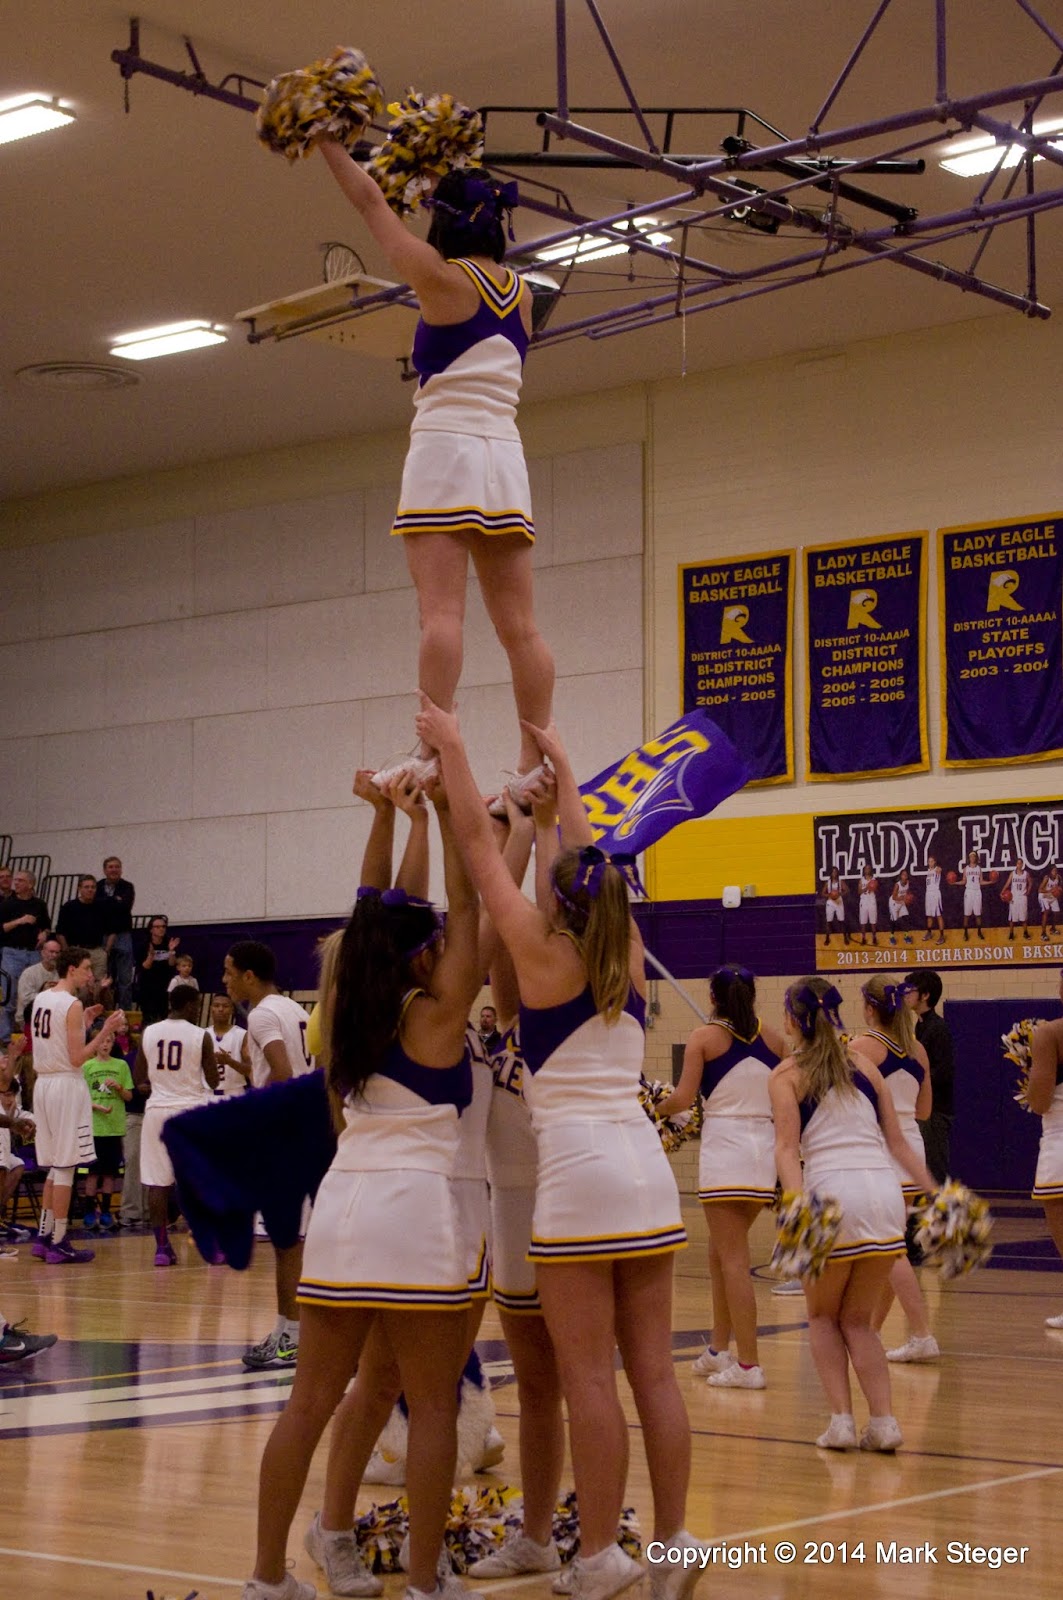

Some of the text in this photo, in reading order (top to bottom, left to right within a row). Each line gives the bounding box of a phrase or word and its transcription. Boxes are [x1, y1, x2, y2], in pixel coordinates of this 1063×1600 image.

[953, 525, 1055, 553] LADY EAGLE
[817, 546, 911, 571] LADY EAGLE
[951, 543, 1057, 570] BASKETBALL
[692, 563, 781, 587] LADY EAGLE
[815, 563, 912, 588] BASKETBALL
[689, 580, 782, 604] BASKETBALL
[986, 569, 1025, 613] R
[847, 588, 883, 630] R
[720, 604, 755, 645] R
[953, 611, 1057, 632] DISTRICT 10-AAAAA
[814, 628, 910, 648] DISTRICT 10-AAAAA
[982, 628, 1029, 644] STATE
[691, 643, 781, 662] DISTRICT 10-AAAAA
[832, 644, 898, 662] DISTRICT
[968, 642, 1045, 662] PLAYOFFS
[697, 657, 774, 676] BI-DISTRICT
[821, 658, 904, 678] CHAMPIONS
[959, 665, 999, 679] 2003
[1013, 659, 1049, 674] 2004
[697, 672, 776, 690] CHAMPIONS
[822, 681, 856, 693] 2004
[870, 676, 905, 689] 2005
[696, 695, 729, 706] 2004
[741, 689, 776, 702] 2005
[821, 695, 856, 708] 2005
[869, 690, 905, 703] 2006
[818, 819, 938, 881] LADY
[837, 950, 908, 965] 2013-2014
[916, 946, 1014, 962] RICHARDSON
[34, 1007, 51, 1039] 40
[157, 1039, 183, 1071] 10
